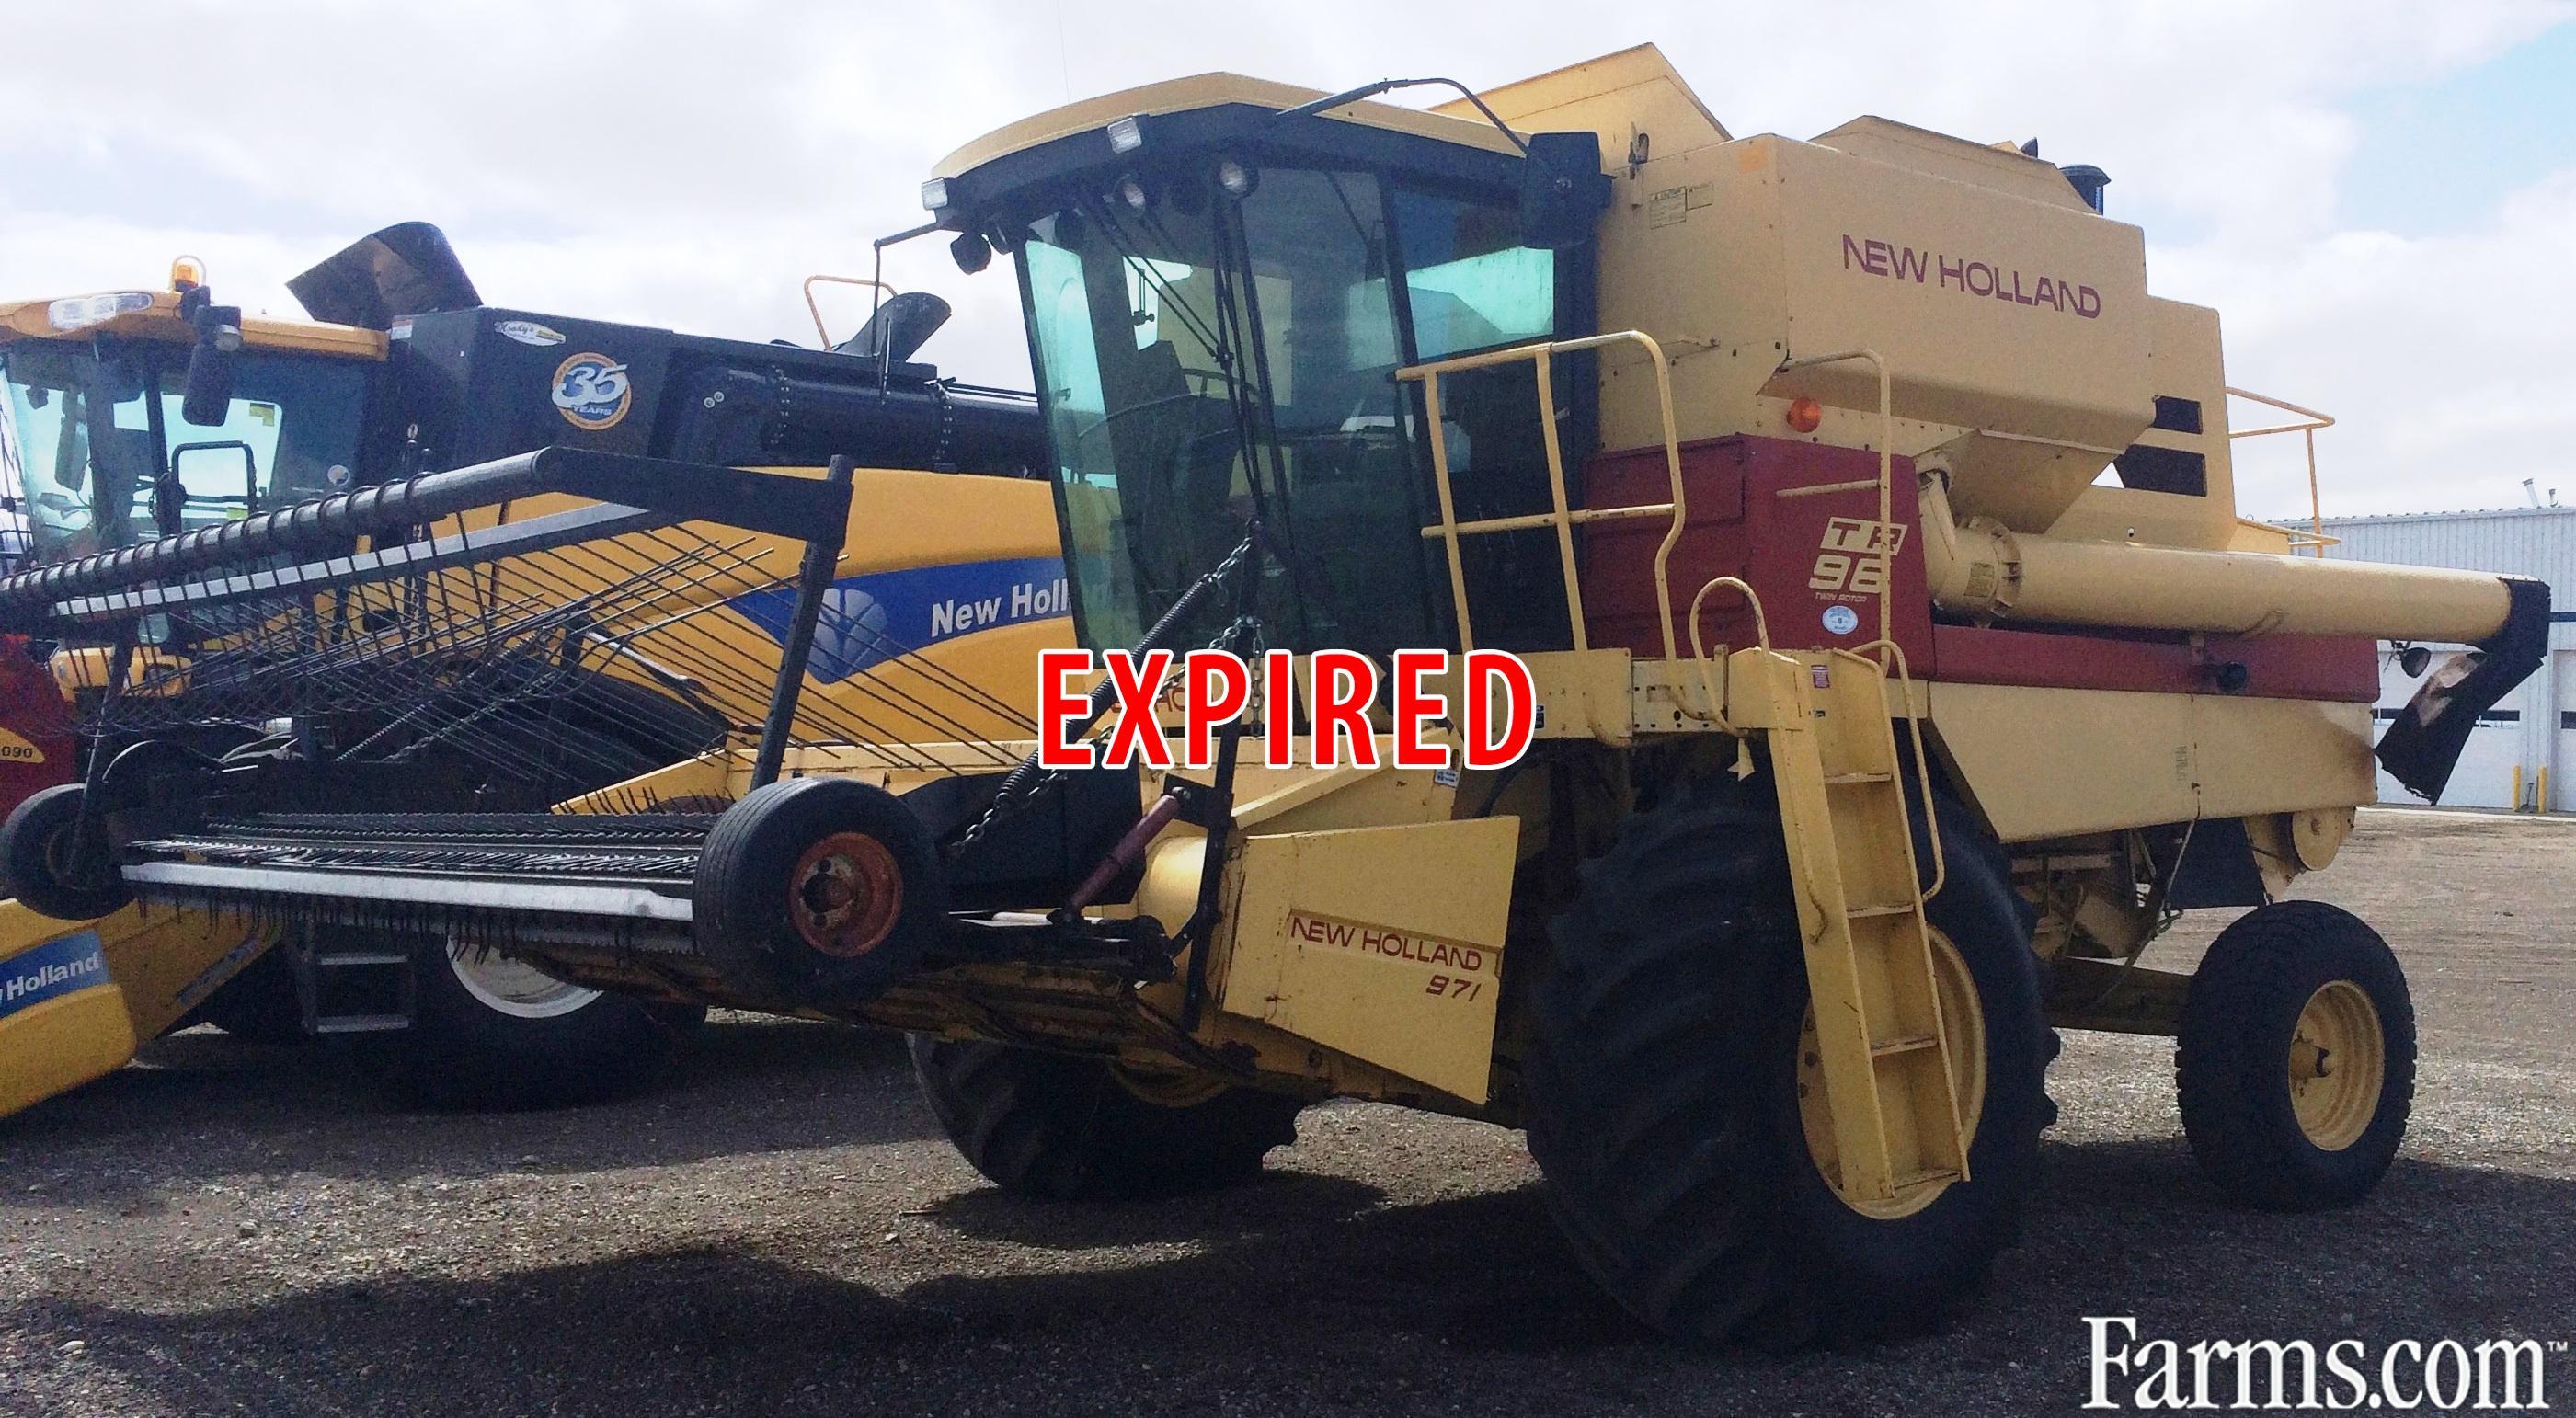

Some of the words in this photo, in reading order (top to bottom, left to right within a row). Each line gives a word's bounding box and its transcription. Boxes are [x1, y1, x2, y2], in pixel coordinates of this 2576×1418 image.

[1842, 234, 1929, 283] NEW
[1938, 254, 2101, 319] HOLLAND
[552, 364, 628, 409] 35
[573, 405, 612, 416] YEARS
[931, 597, 1002, 638] New
[1011, 578, 1072, 619] Holl
[1815, 591, 1838, 600] TWIN
[1838, 593, 1868, 602] ROTOR
[1290, 917, 1356, 947] NEW
[1361, 930, 1483, 971] HOLLAND
[6, 951, 101, 1001] Holland
[1425, 974, 1483, 1002] 971
